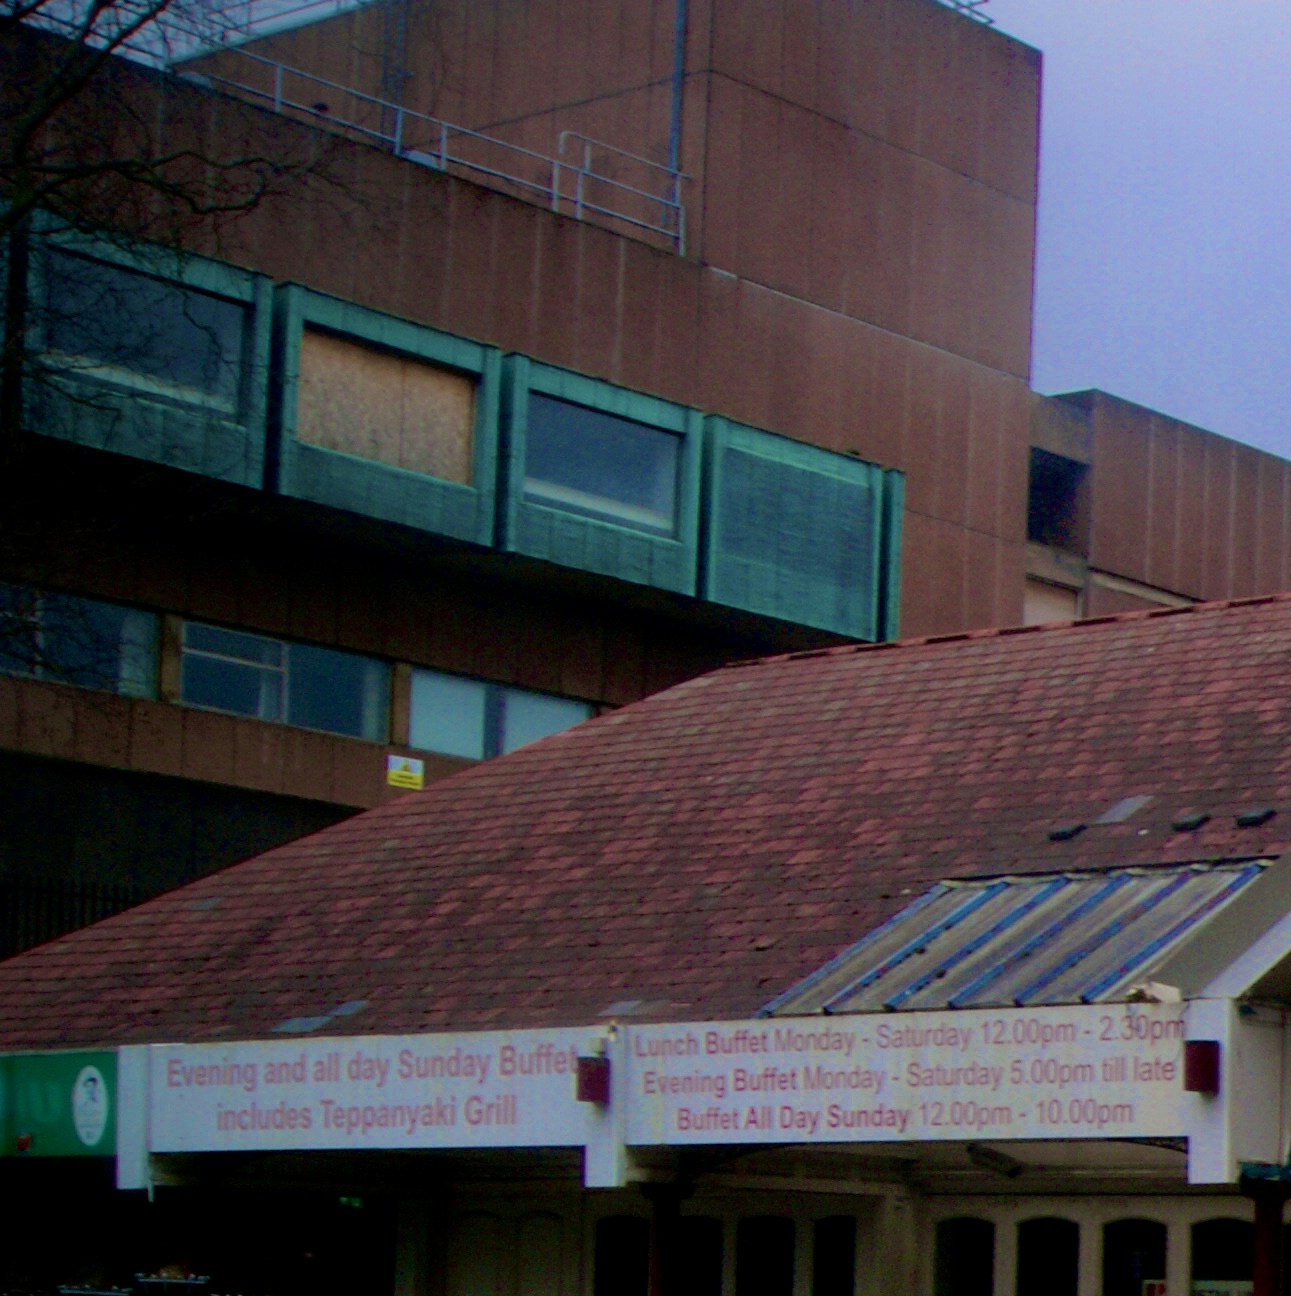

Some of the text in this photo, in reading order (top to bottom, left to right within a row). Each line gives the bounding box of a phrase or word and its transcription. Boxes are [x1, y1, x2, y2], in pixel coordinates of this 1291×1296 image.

[634, 1033, 699, 1058] Lunch
[705, 1028, 768, 1056] Buffet
[774, 1027, 856, 1057] Monday
[876, 1018, 972, 1051] Saturday
[981, 1017, 1077, 1049] 12.00pm
[1098, 1014, 1186, 1046] 2.30pm
[166, 1043, 579, 1092] Evening and all day Sunday Buffet
[642, 1069, 726, 1099] Evening
[732, 1066, 798, 1093] Buffet
[803, 1064, 886, 1094] Monday
[906, 1058, 1004, 1092] Saturday
[1009, 1060, 1094, 1090] 5.00pm
[1102, 1055, 1126, 1082] till
[1133, 1055, 1176, 1082] late
[216, 1093, 518, 1138] includes Teppanyaki Grill
[676, 1106, 739, 1131] Buffet
[744, 1104, 772, 1130] All
[780, 1104, 822, 1135] Day
[827, 1103, 911, 1134] Sunday
[919, 1102, 1012, 1131] 12.00pm
[1036, 1099, 1134, 1128] 10.00pm
